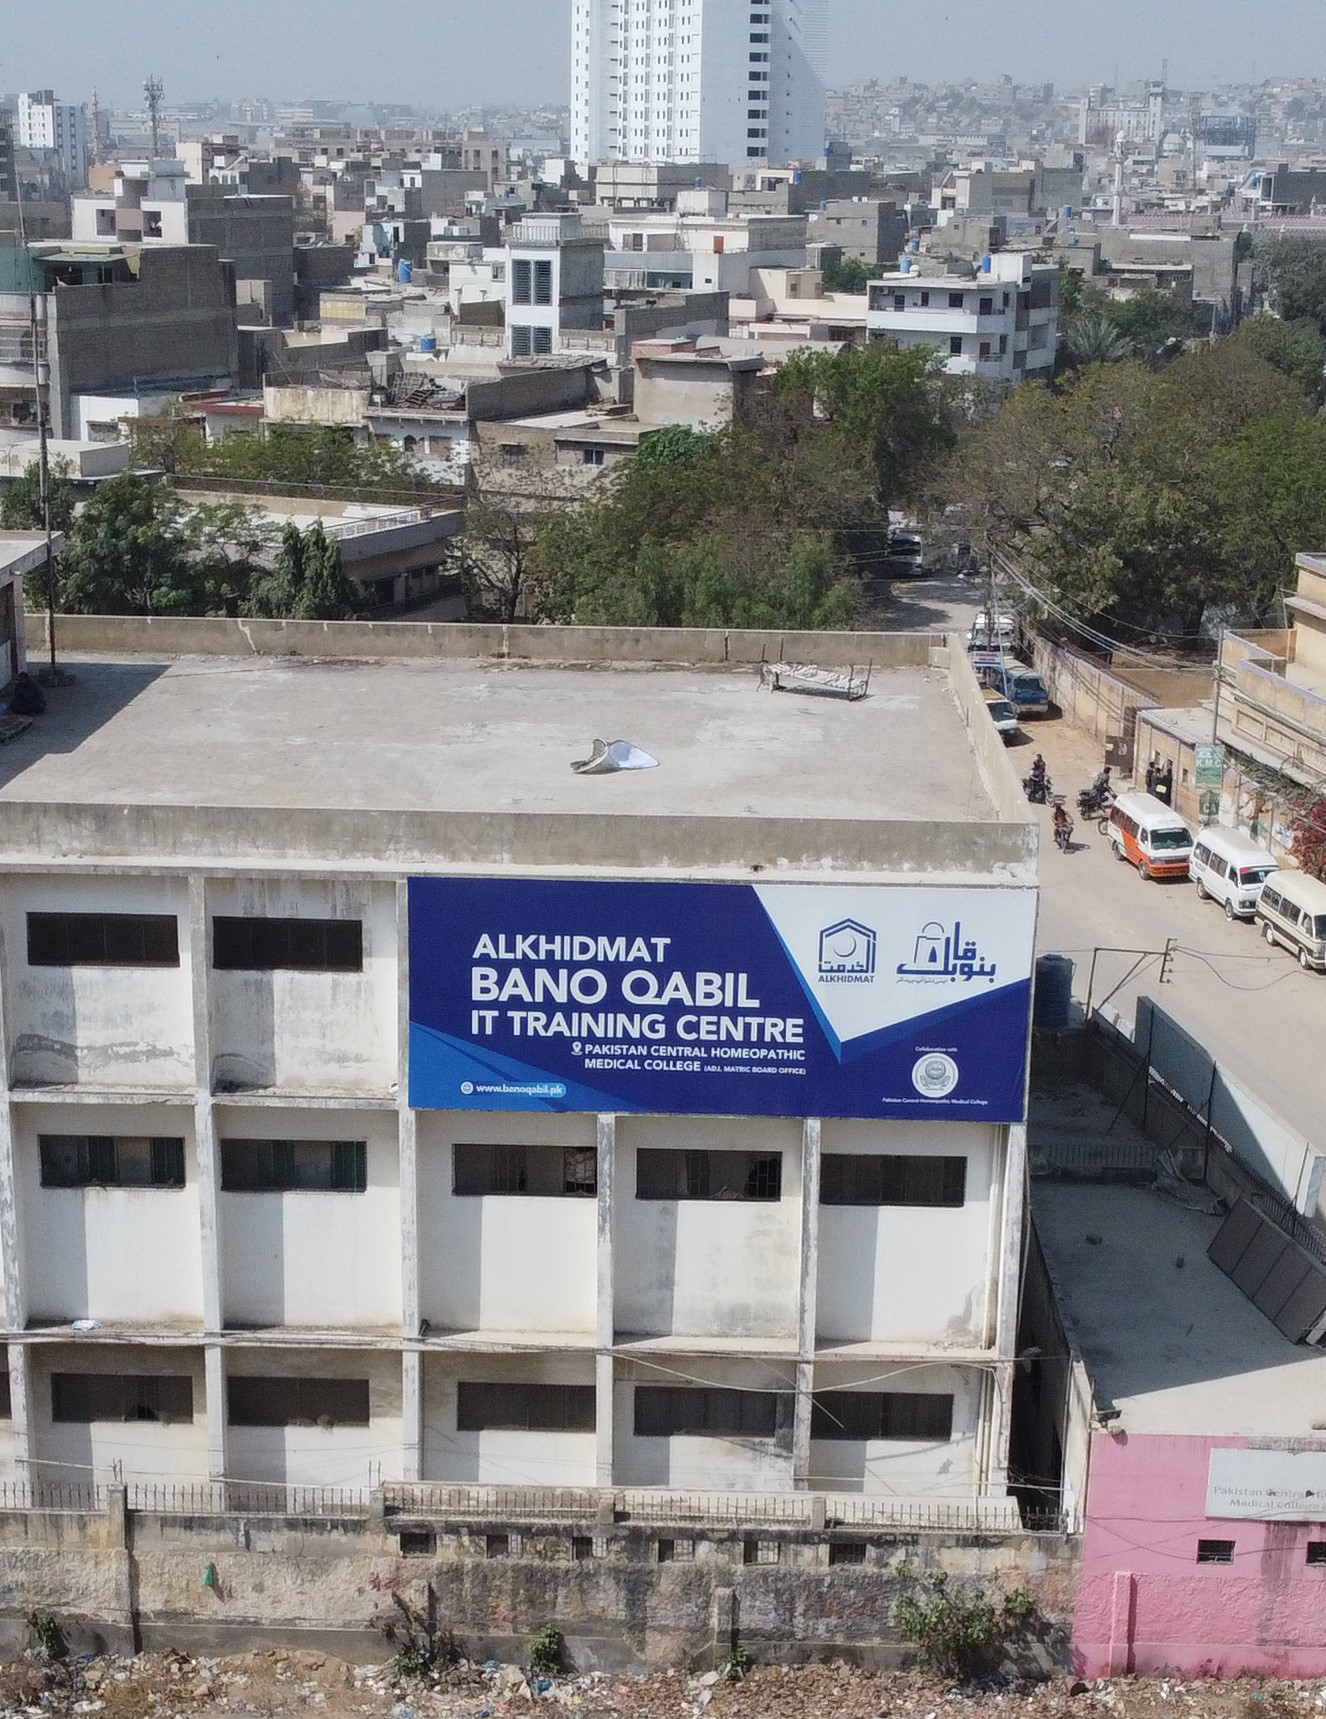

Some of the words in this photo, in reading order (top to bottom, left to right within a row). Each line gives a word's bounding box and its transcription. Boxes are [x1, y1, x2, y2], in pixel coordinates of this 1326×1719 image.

[472, 933, 671, 962] ALKHIDMAT
[471, 966, 607, 1004] BANO
[621, 969, 760, 1008] QABIL
[817, 975, 875, 984] ALKHIDMAT
[471, 1010, 499, 1035] IT
[507, 1010, 666, 1040] TRAINING
[676, 1014, 804, 1043] CENTRE
[584, 1044, 648, 1056] PAKISTAN
[650, 1045, 708, 1058] CENTRAL
[711, 1047, 806, 1061] HOMEOPATHIC
[584, 1058, 642, 1070] MEDICAL
[644, 1059, 701, 1072] COLLEGE
[723, 1065, 751, 1073] MATRIC
[475, 1083, 563, 1096] www.banoqabil.pk
[1213, 1486, 1263, 1497] Pakistan
[1229, 1499, 1274, 1509] Medical
